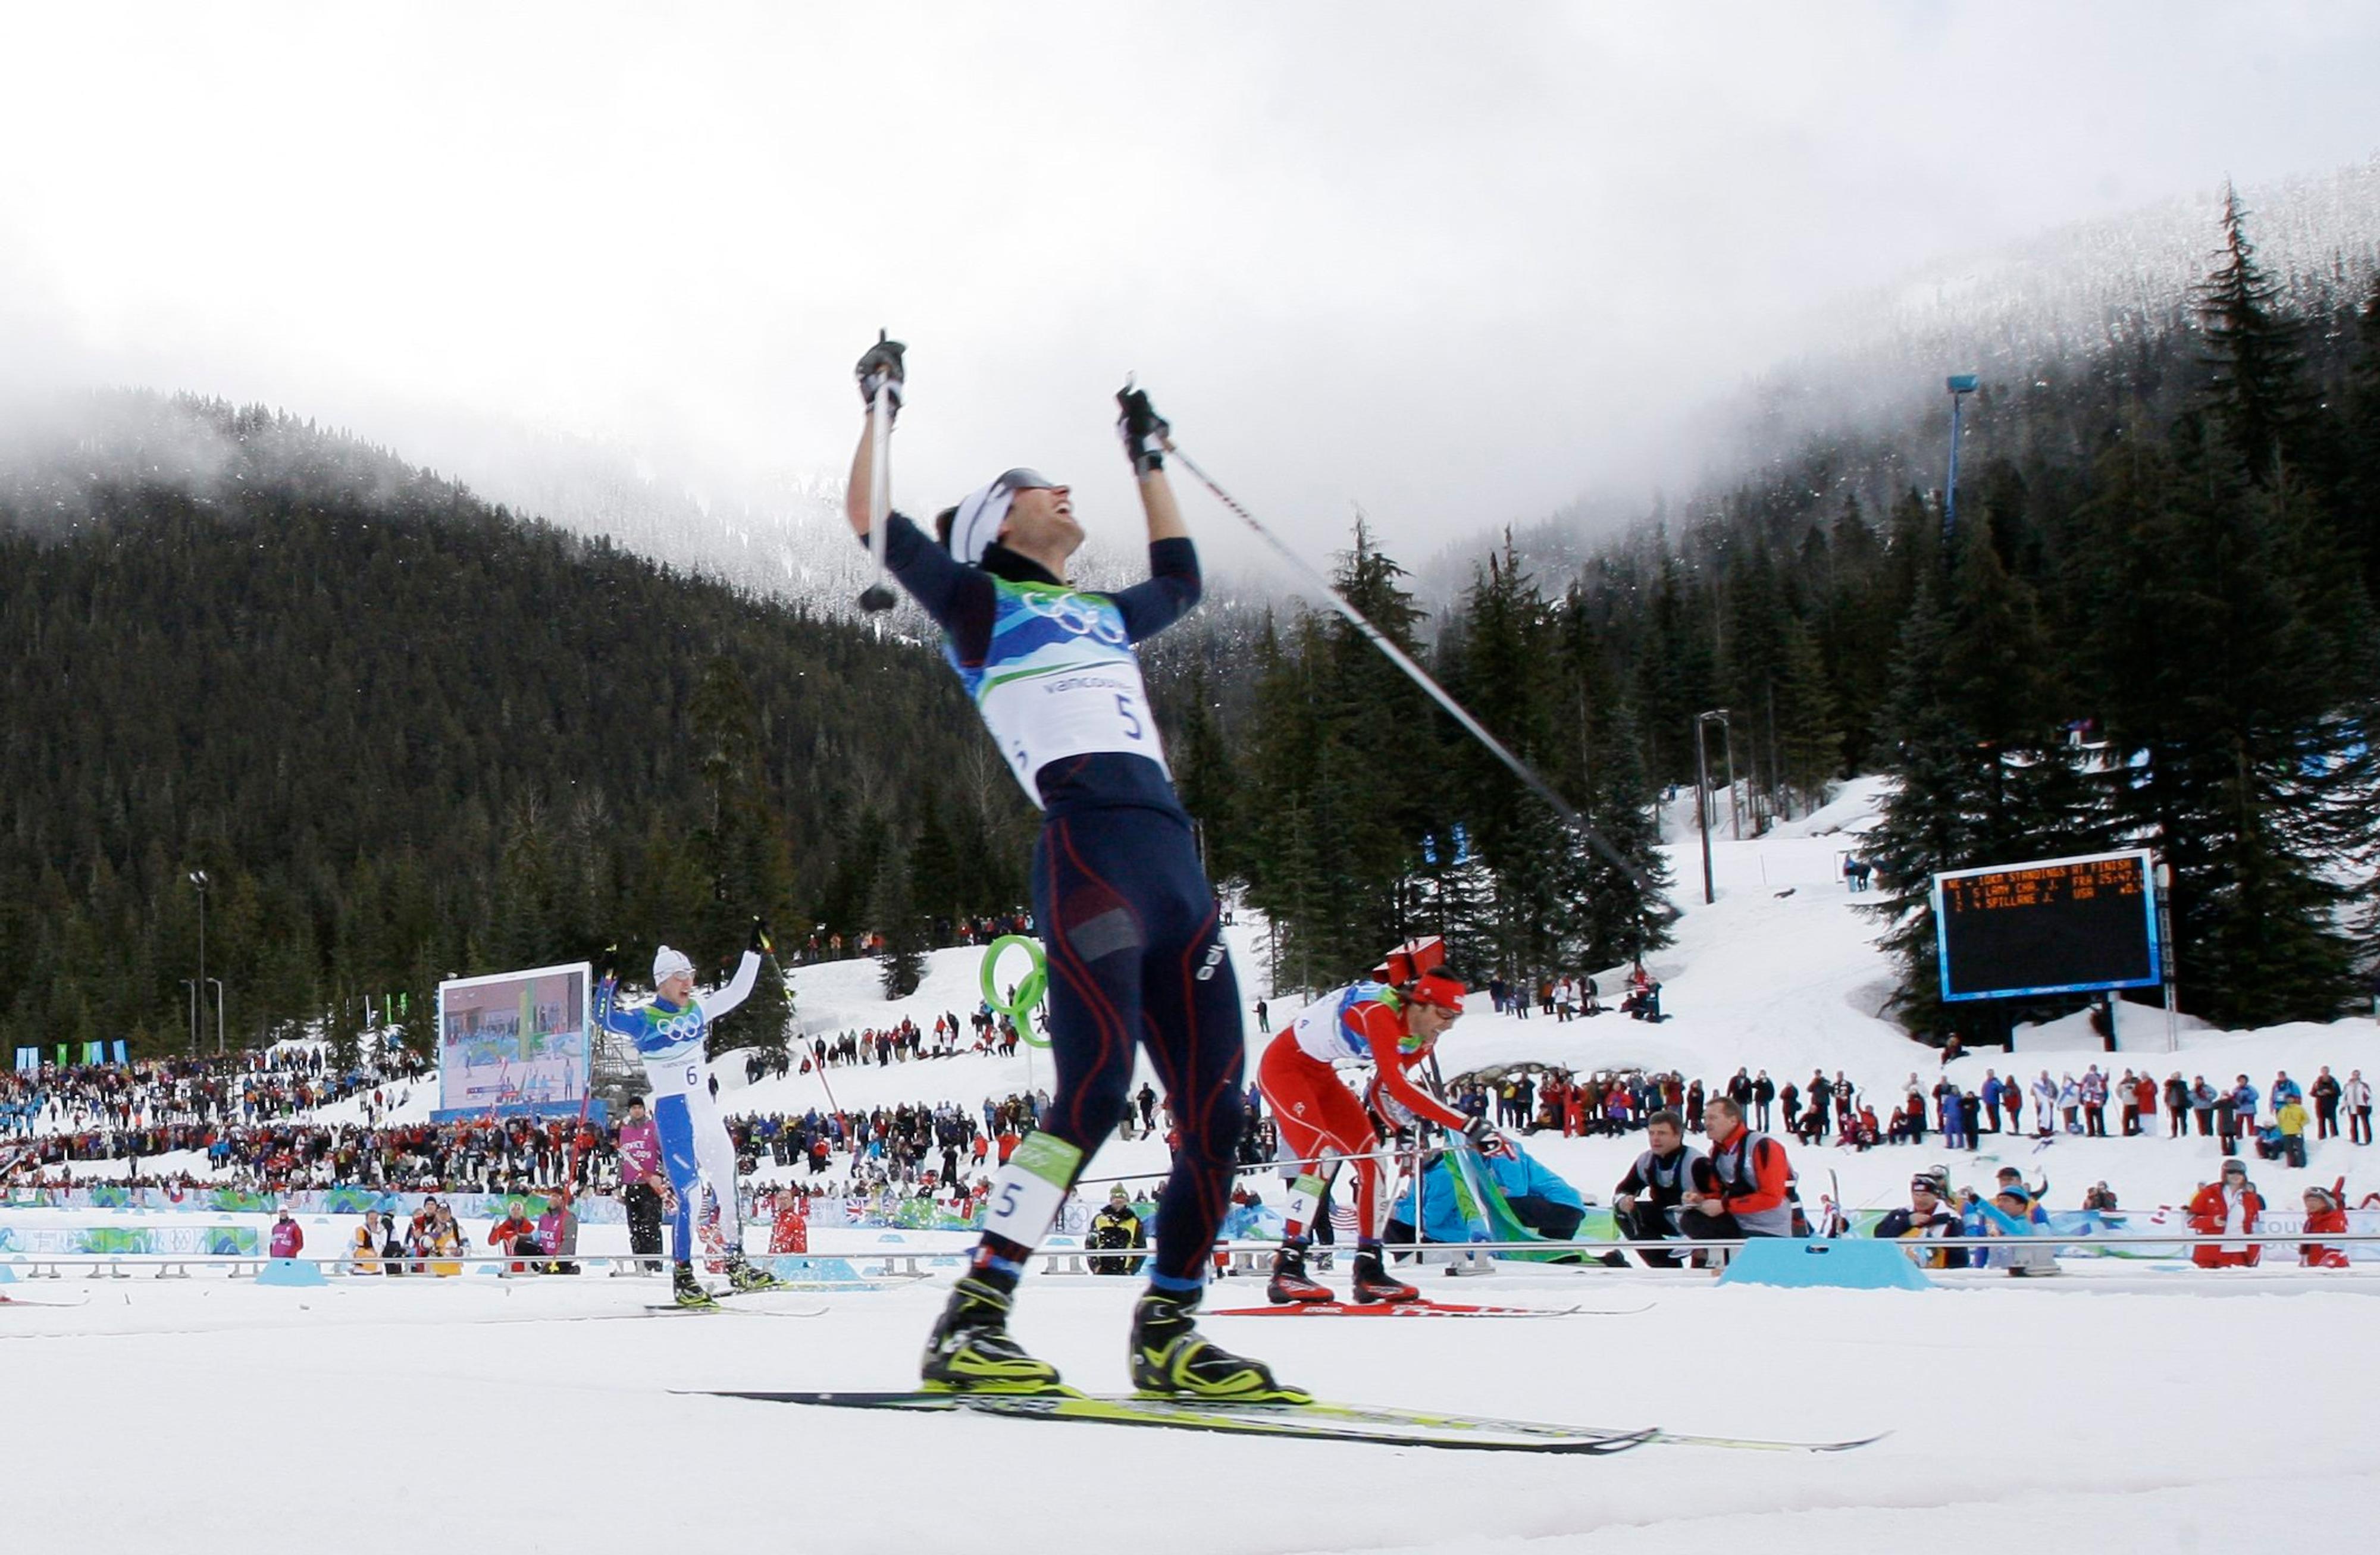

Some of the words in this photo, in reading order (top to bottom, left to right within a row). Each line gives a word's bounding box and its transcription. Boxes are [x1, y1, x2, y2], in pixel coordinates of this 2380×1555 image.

[1116, 694, 1142, 740] 5
[2091, 859, 2132, 872] FINISH
[2072, 875, 2093, 887] FRA
[686, 1065, 698, 1085] 6
[994, 1182, 1023, 1217] 5
[1292, 1199, 1303, 1213] 4
